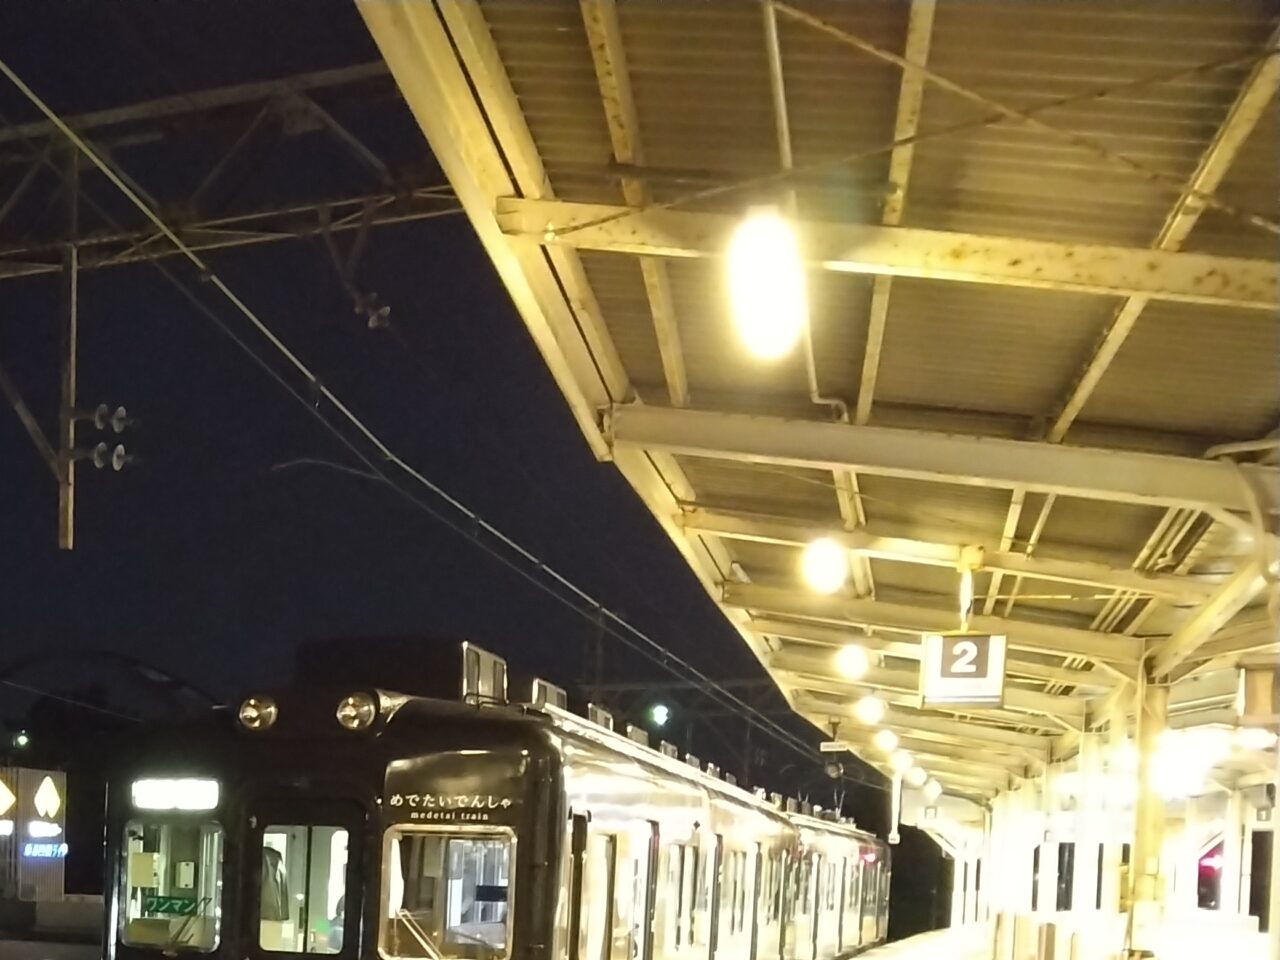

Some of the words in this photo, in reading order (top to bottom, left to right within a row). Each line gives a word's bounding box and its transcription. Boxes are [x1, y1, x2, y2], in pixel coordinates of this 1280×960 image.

[950, 640, 978, 673] 2
[390, 794, 512, 809] めでたいでんしゃ
[410, 811, 456, 820] medetai
[461, 812, 489, 821] train
[146, 897, 196, 913] ワンマン
